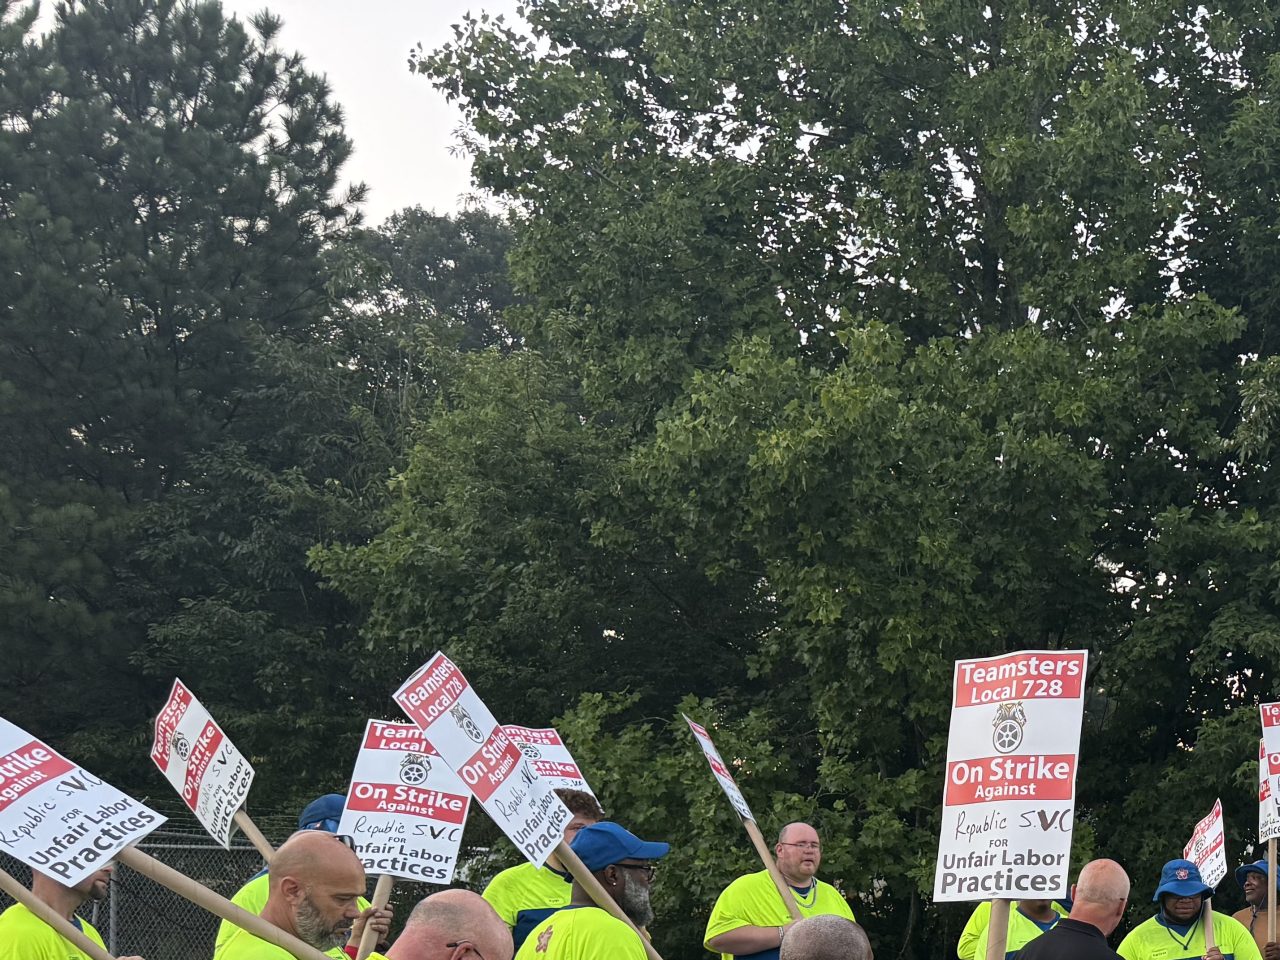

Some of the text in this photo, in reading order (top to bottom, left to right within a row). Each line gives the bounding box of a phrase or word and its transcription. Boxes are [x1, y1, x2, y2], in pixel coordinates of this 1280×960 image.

[400, 659, 455, 711] Teamsters
[961, 657, 1079, 684] Teamsters
[420, 677, 463, 722] Local 728
[971, 680, 1063, 704] Local 728
[153, 686, 184, 759] Teamsters
[163, 702, 187, 762] Local 728
[380, 739, 425, 752] Local
[529, 737, 550, 745] 728
[185, 726, 215, 799] On Strike
[194, 751, 212, 791] Against
[462, 731, 510, 785] On Strike
[488, 754, 515, 785] Against
[952, 756, 1069, 785] On Strike
[211, 758, 244, 834] Unfair Labor
[213, 784, 222, 799] FOR
[218, 767, 251, 844] Practices
[355, 783, 462, 811] On Strike
[529, 799, 537, 809] FOR
[975, 783, 1036, 800] Against
[61, 808, 83, 823] FOR
[377, 801, 434, 816] Against
[515, 790, 555, 845] Unfair Labor
[28, 798, 133, 865] Unfair Labor
[354, 816, 405, 836] Republic
[525, 804, 568, 861] Practices
[955, 810, 1007, 842] Republic
[49, 810, 155, 879] Practices
[352, 843, 452, 863] nfair Labor
[990, 839, 1008, 848] FOR
[943, 849, 1064, 869] Unfair Labor
[941, 869, 1060, 893] Practices
